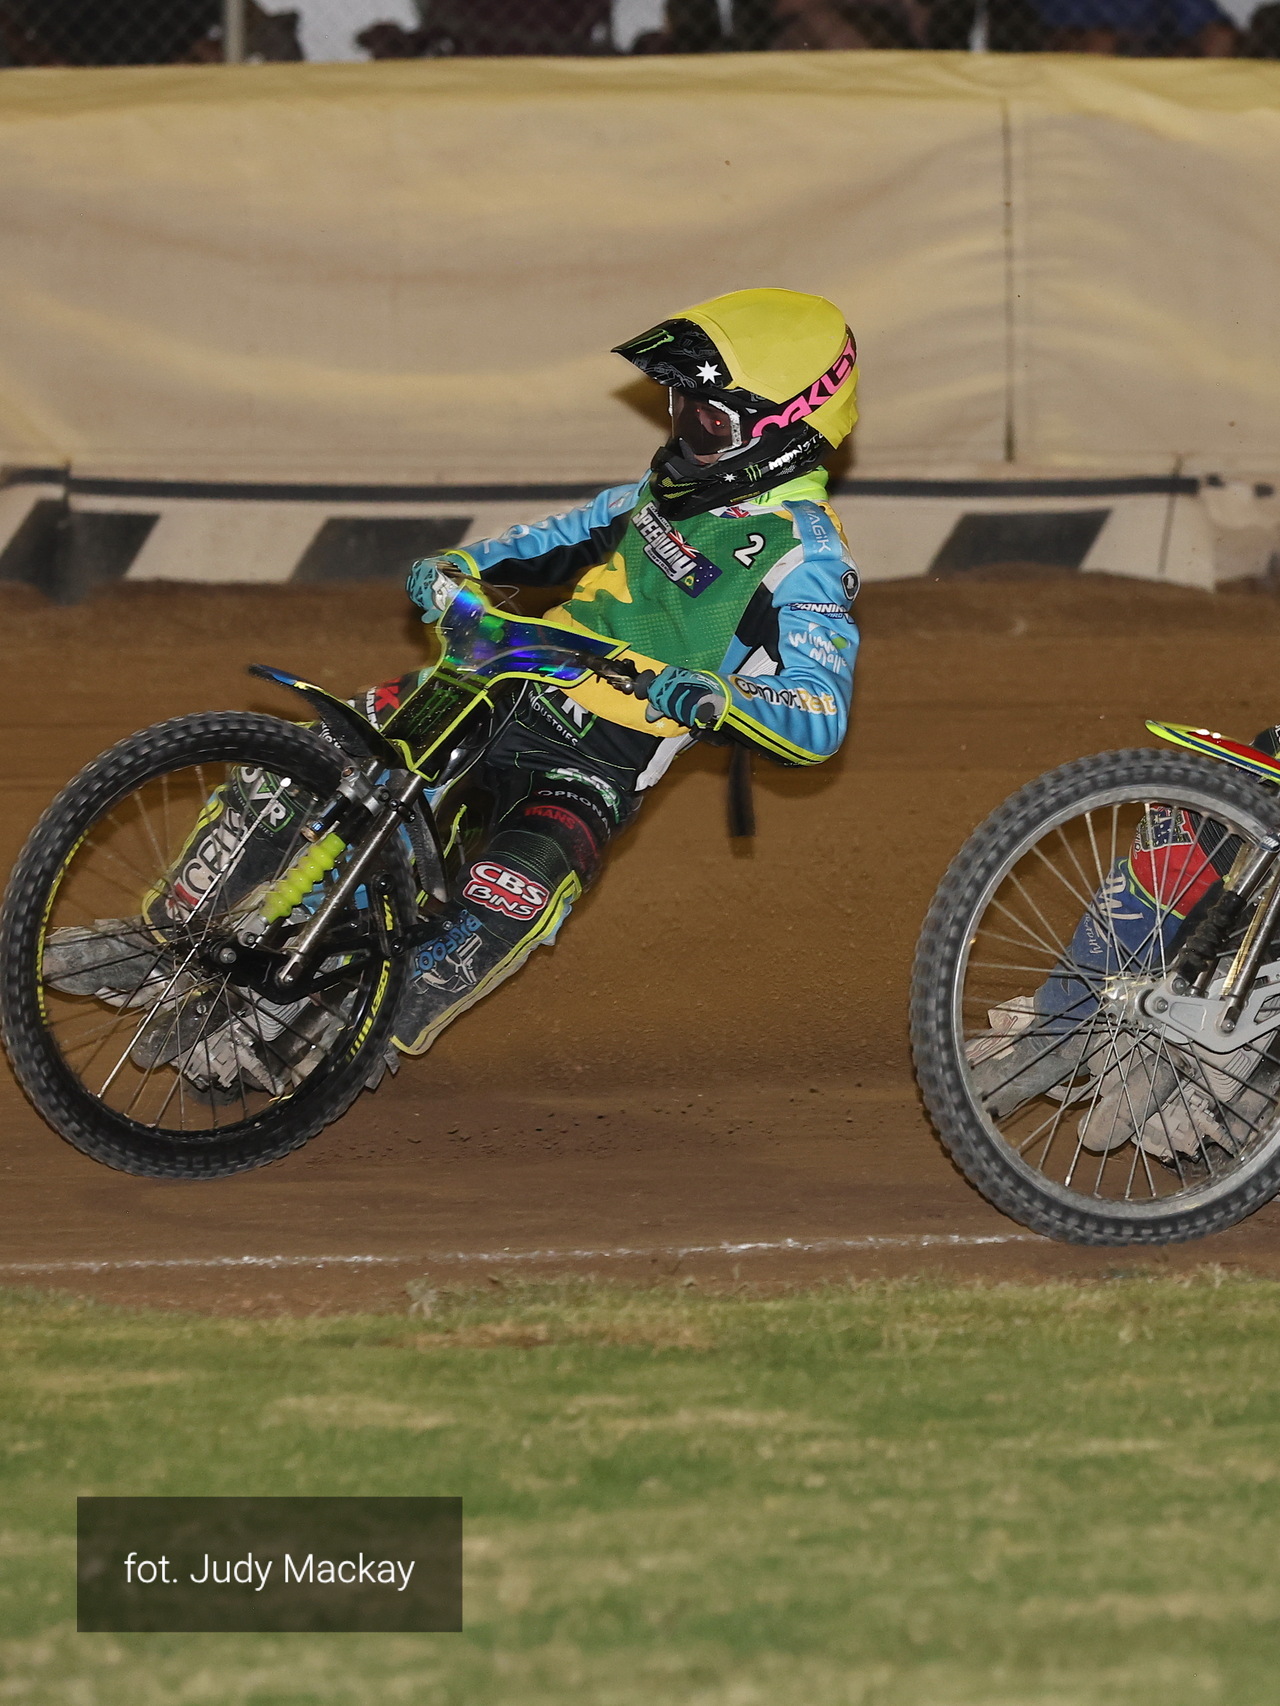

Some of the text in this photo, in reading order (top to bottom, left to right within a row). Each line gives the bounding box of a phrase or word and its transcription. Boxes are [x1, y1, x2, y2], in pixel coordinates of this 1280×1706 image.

[632, 501, 698, 581] SPEEDWAY
[734, 533, 765, 568] 2
[467, 884, 535, 916] BINS
[475, 864, 547, 906] CBS
